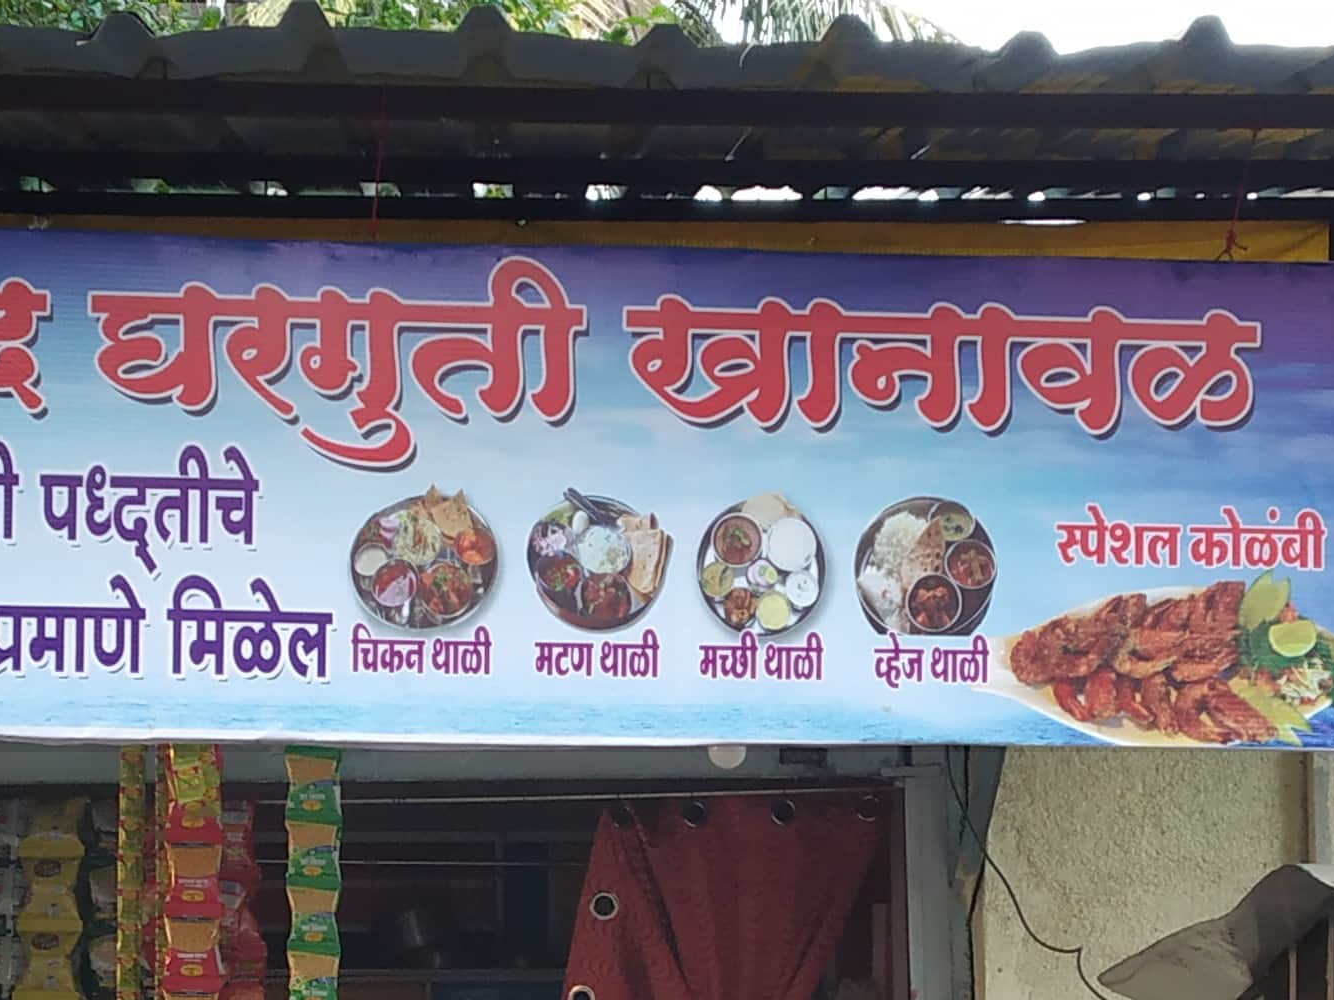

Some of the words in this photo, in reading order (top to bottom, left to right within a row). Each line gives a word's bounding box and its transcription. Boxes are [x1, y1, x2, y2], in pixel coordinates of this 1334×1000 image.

[90, 260, 584, 464] घरगुती
[627, 297, 1259, 432] खानावळ
[1057, 504, 1181, 566] स्पेशल
[1189, 507, 1325, 570] कोळंबी
[167, 575, 333, 677] मिळेल
[351, 623, 426, 673] चिकन
[432, 626, 492, 675] थाळी
[535, 642, 594, 676] मटण
[600, 629, 660, 677] थाळी
[699, 630, 758, 680] मच्छी
[765, 632, 824, 680] थाळी
[874, 631, 925, 688] व्हेज
[930, 635, 990, 683] थाळी
